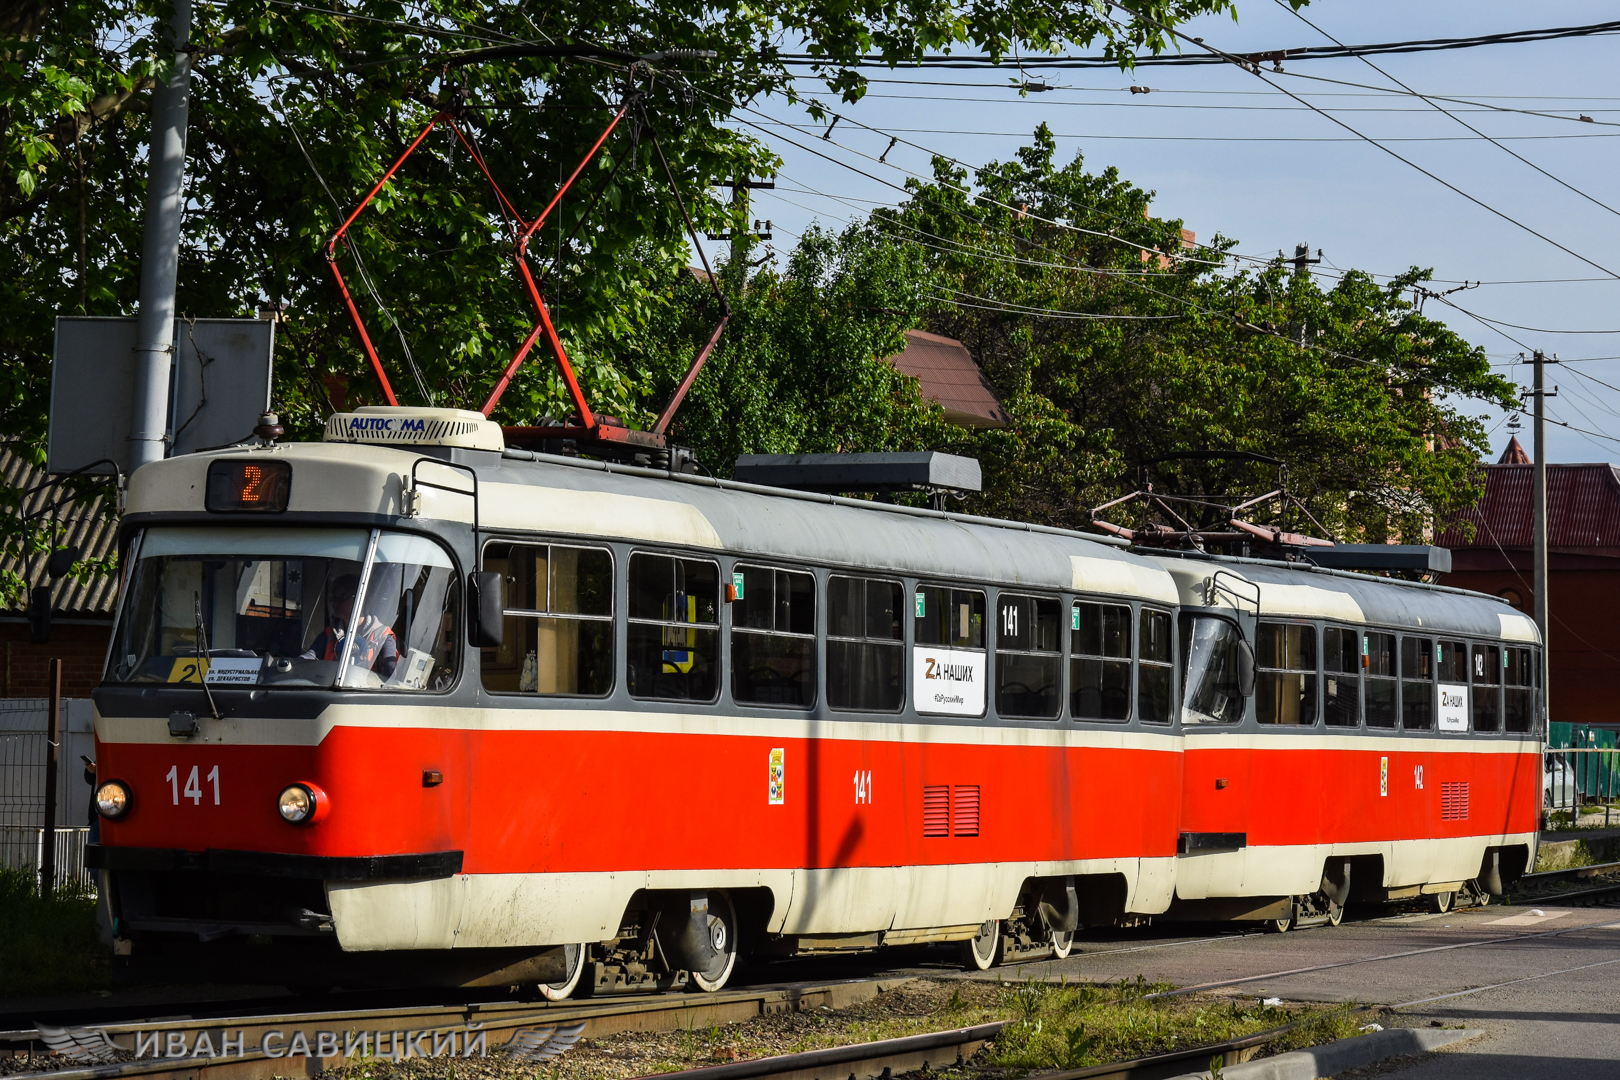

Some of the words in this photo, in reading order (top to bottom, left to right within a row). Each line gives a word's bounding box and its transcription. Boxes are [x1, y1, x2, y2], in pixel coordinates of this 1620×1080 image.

[349, 417, 425, 431] AUTOCMA
[242, 466, 261, 501] 2
[1002, 605, 1018, 636] 141
[180, 664, 197, 683] 2
[943, 664, 974, 682] НАШИХ
[1475, 653, 1483, 676] 142
[166, 765, 220, 806] 141
[853, 770, 872, 804] 141
[1414, 765, 1424, 790] 142
